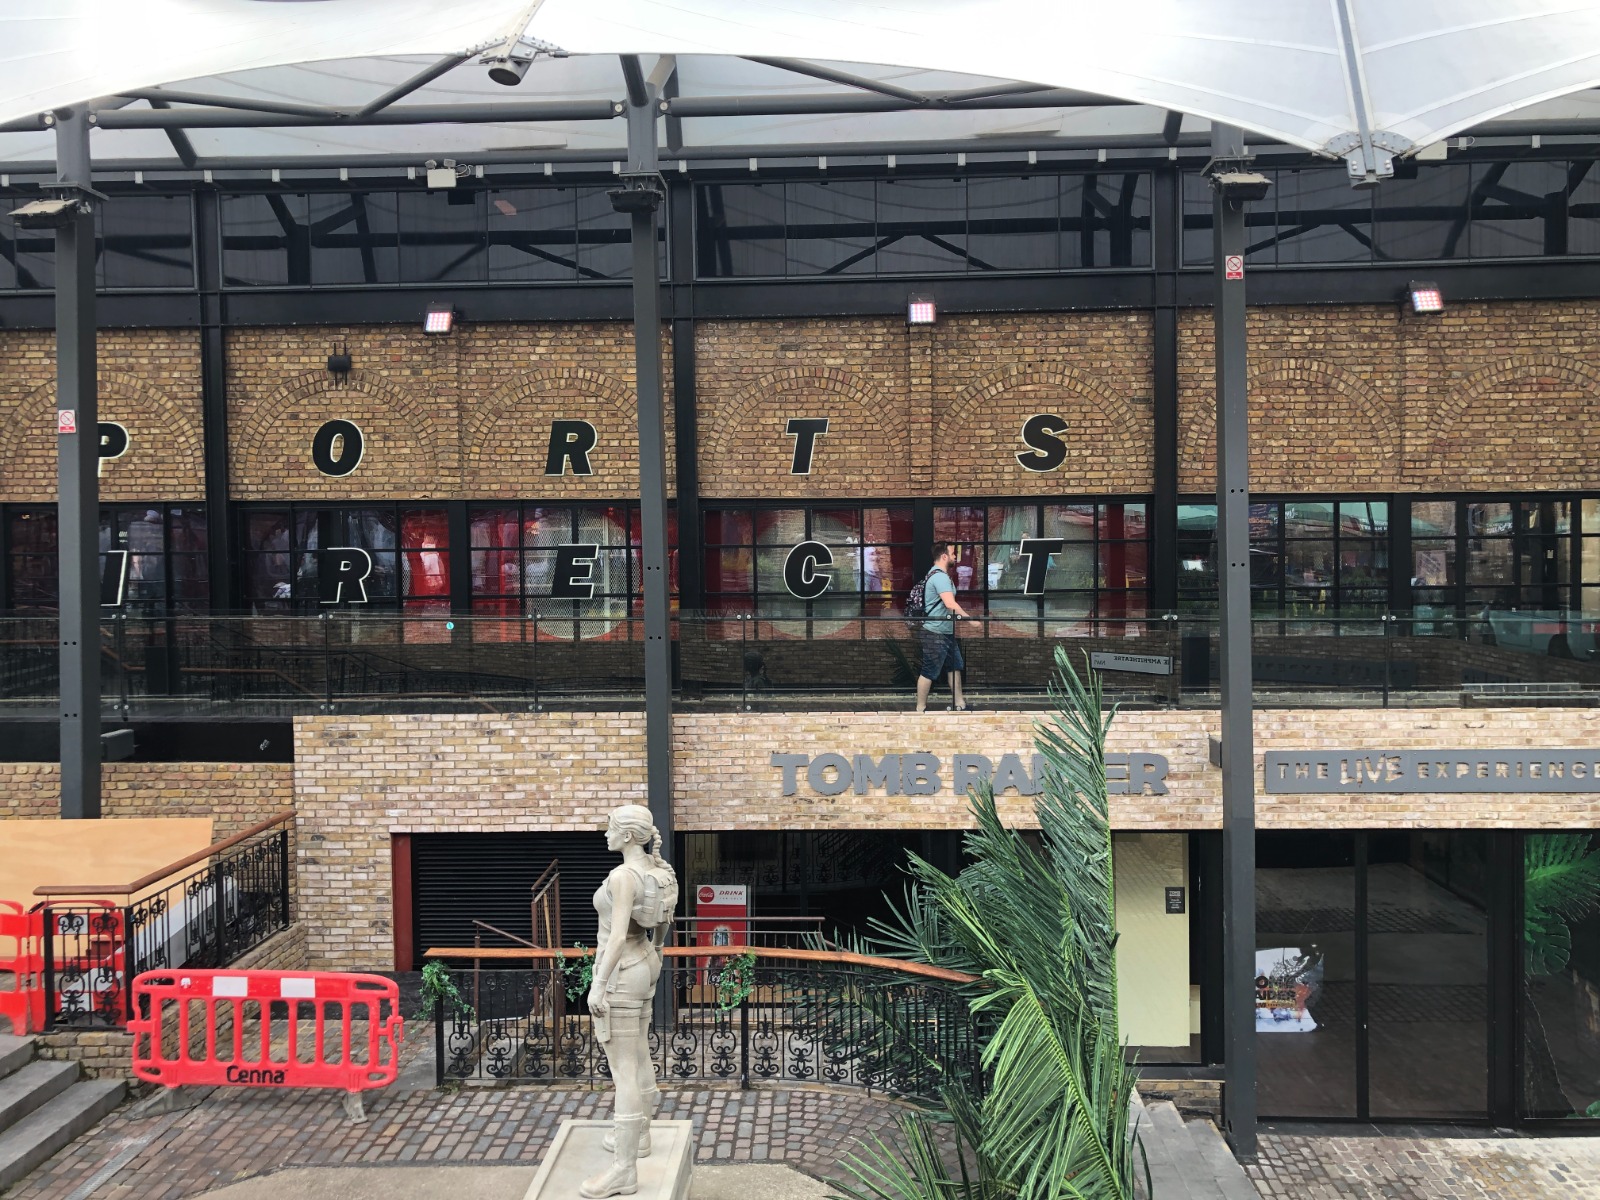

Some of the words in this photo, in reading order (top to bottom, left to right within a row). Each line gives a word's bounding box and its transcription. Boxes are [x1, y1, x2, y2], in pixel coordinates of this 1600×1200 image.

[770, 752, 940, 796] TOMB
[1277, 762, 1329, 780] THE
[1340, 753, 1405, 788] LIVE
[226, 1065, 286, 1084] Cenna
